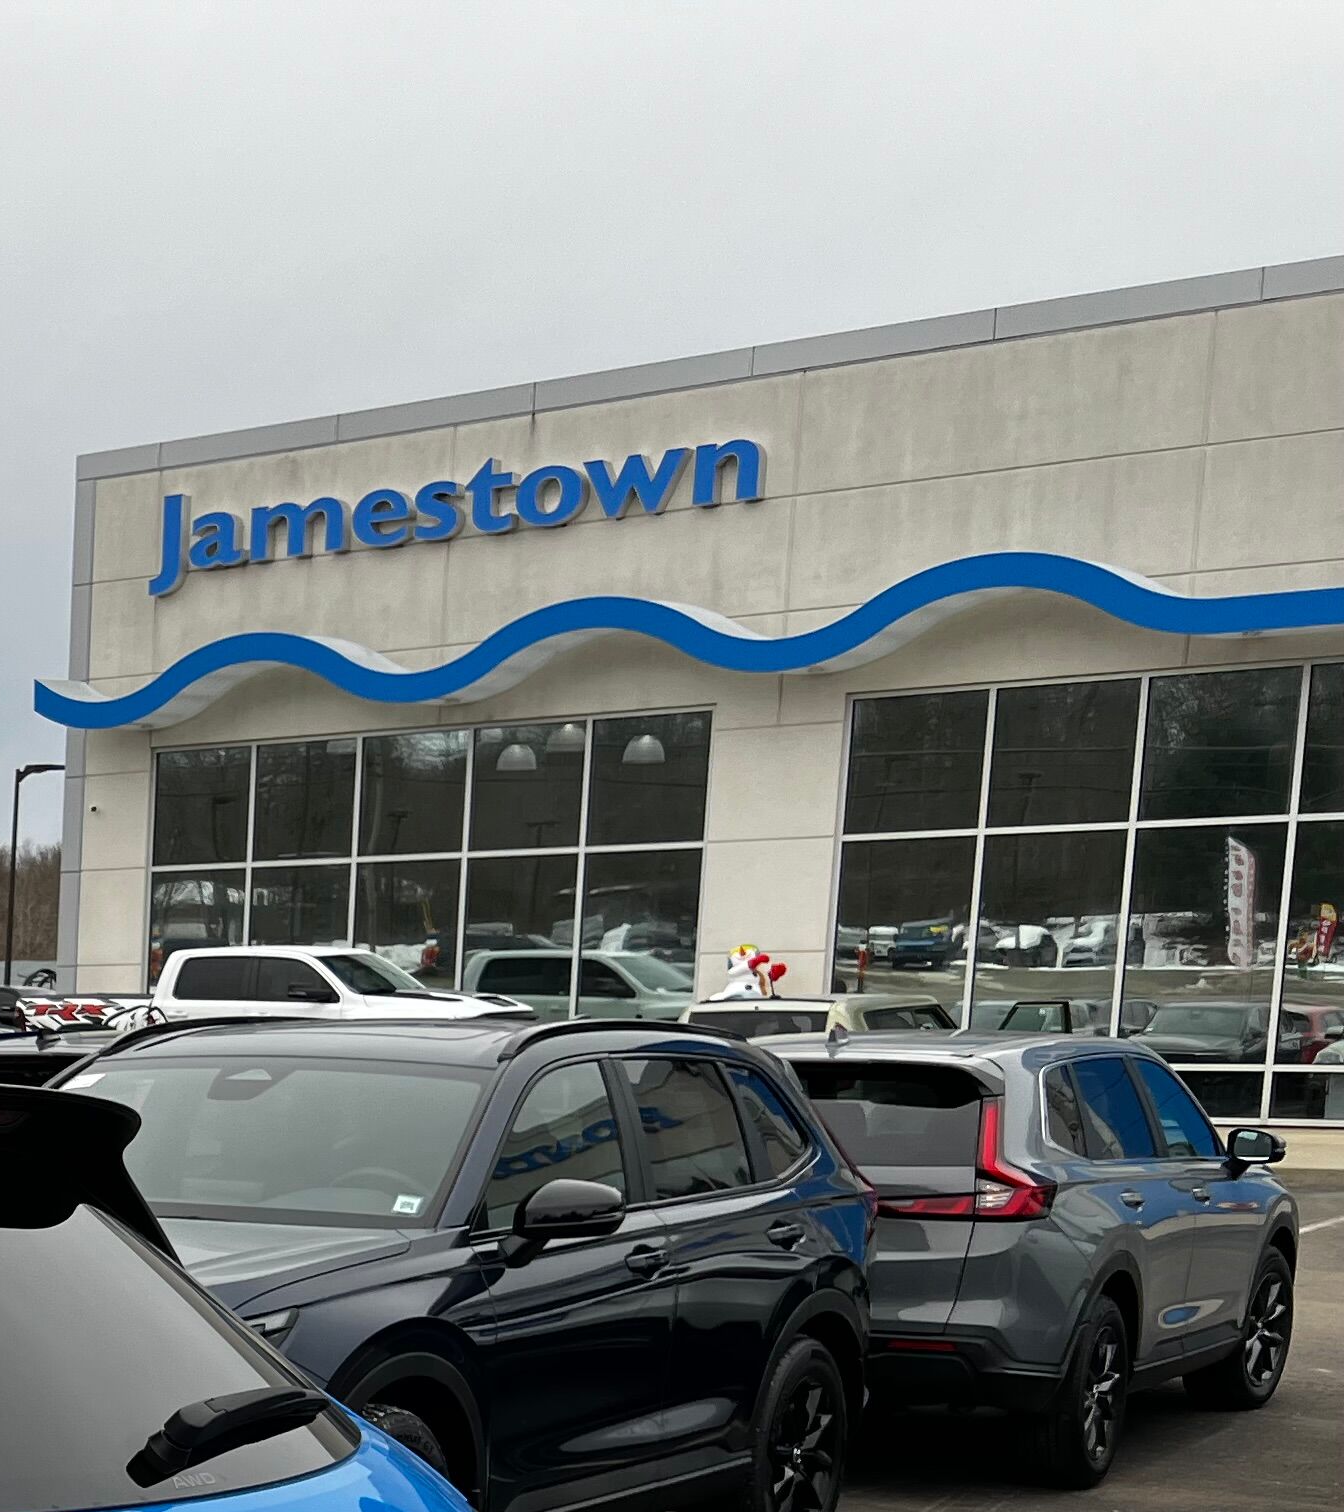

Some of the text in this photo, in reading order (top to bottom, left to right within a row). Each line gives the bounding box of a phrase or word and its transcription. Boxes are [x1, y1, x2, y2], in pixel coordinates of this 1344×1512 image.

[148, 438, 764, 597] Jamestown
[31, 1003, 108, 1022] TRX
[172, 1472, 216, 1489] AWD
